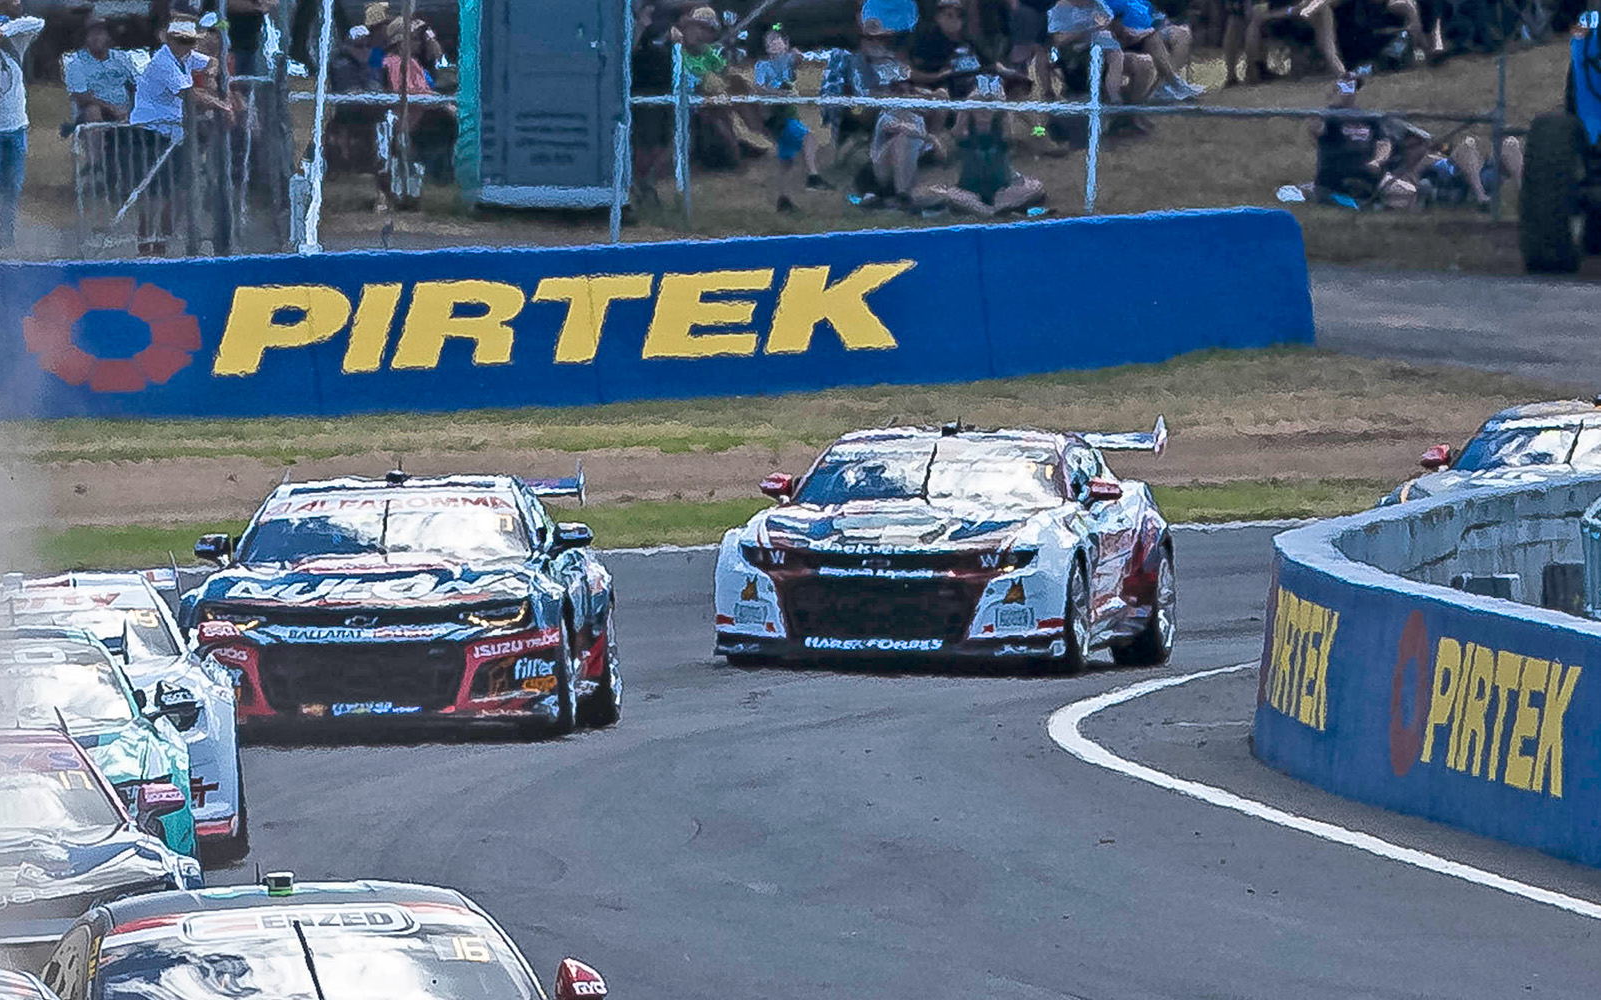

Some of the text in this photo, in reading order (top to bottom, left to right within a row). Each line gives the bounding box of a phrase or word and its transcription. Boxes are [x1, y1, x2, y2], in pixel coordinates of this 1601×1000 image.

[212, 258, 917, 378] PIRTEK
[473, 640, 524, 659] ISUZU
[1420, 635, 1583, 798] PIRTEK
[261, 910, 395, 930] ENZED
